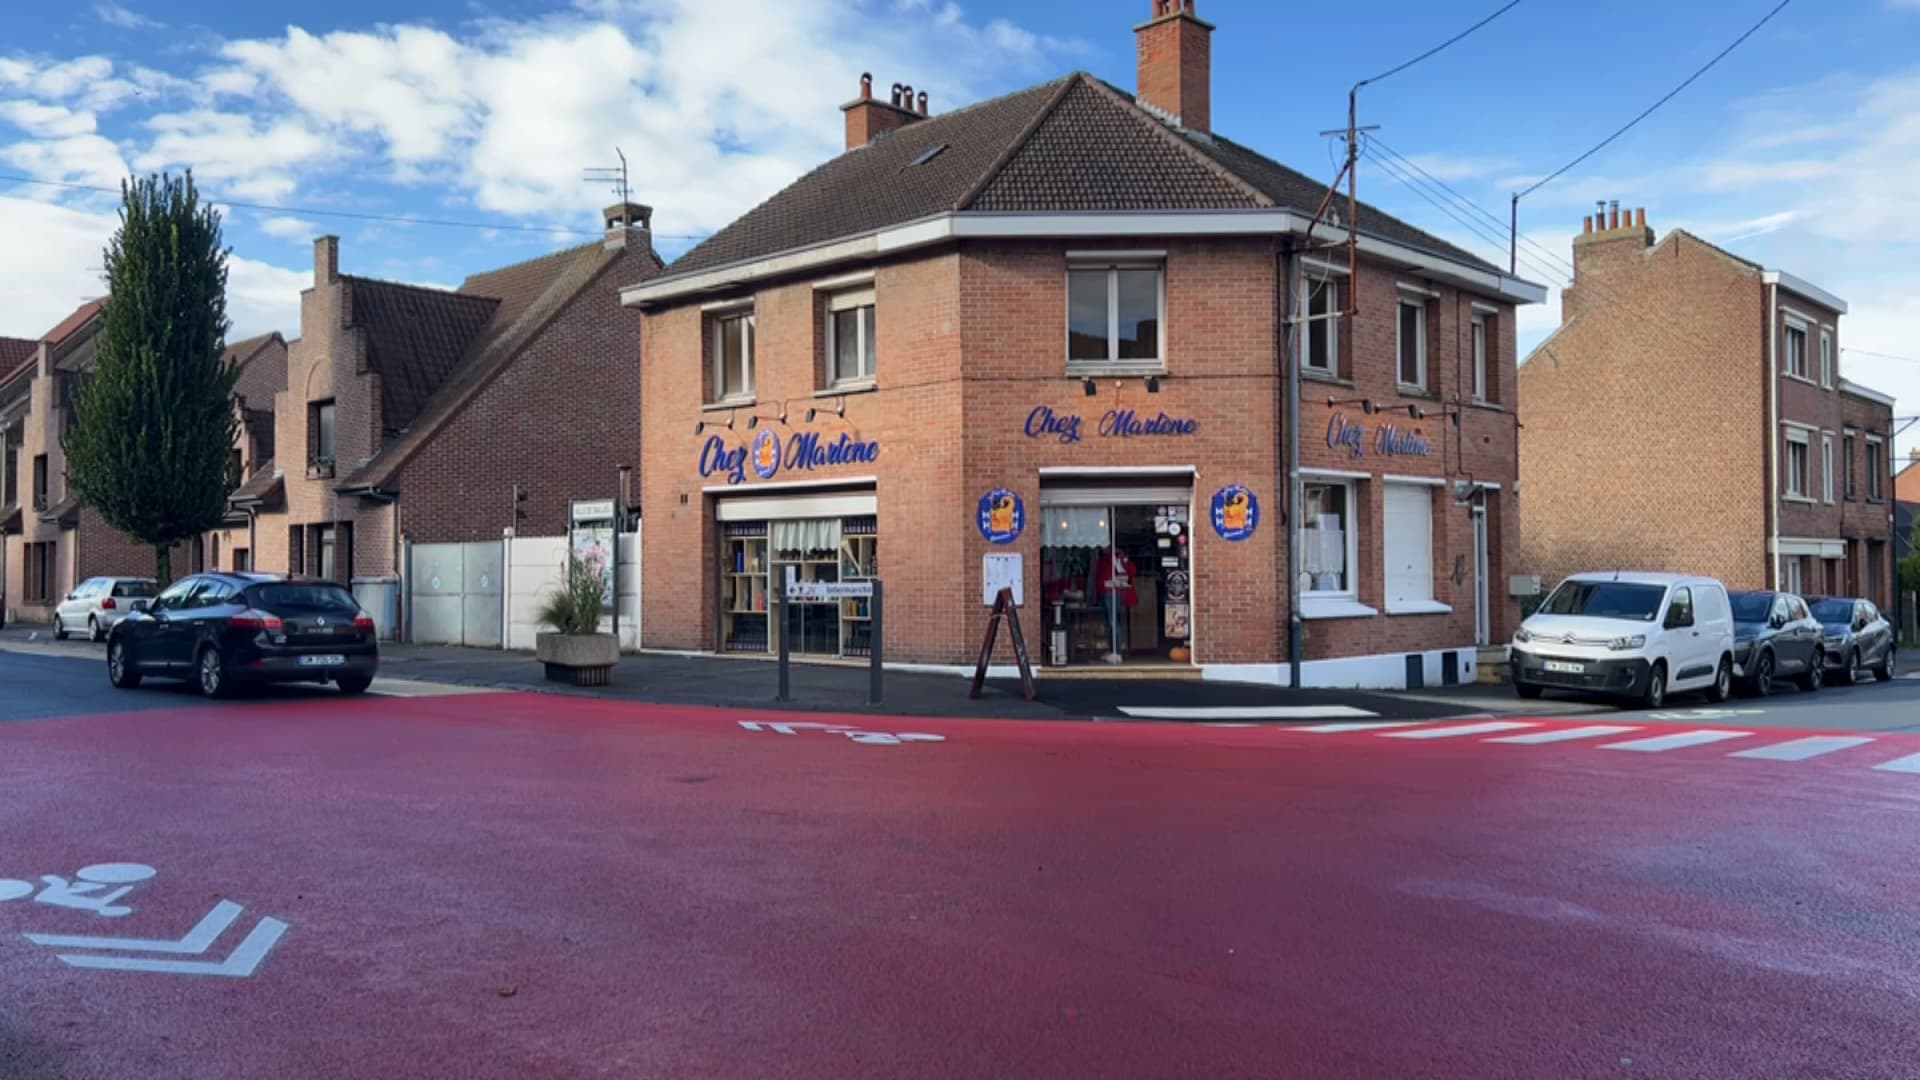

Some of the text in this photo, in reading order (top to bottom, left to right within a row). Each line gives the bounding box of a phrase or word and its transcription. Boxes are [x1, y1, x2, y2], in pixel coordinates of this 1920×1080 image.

[1024, 405, 1081, 444] Chez
[1327, 411, 1365, 458] Chez
[699, 434, 748, 485] Chez
